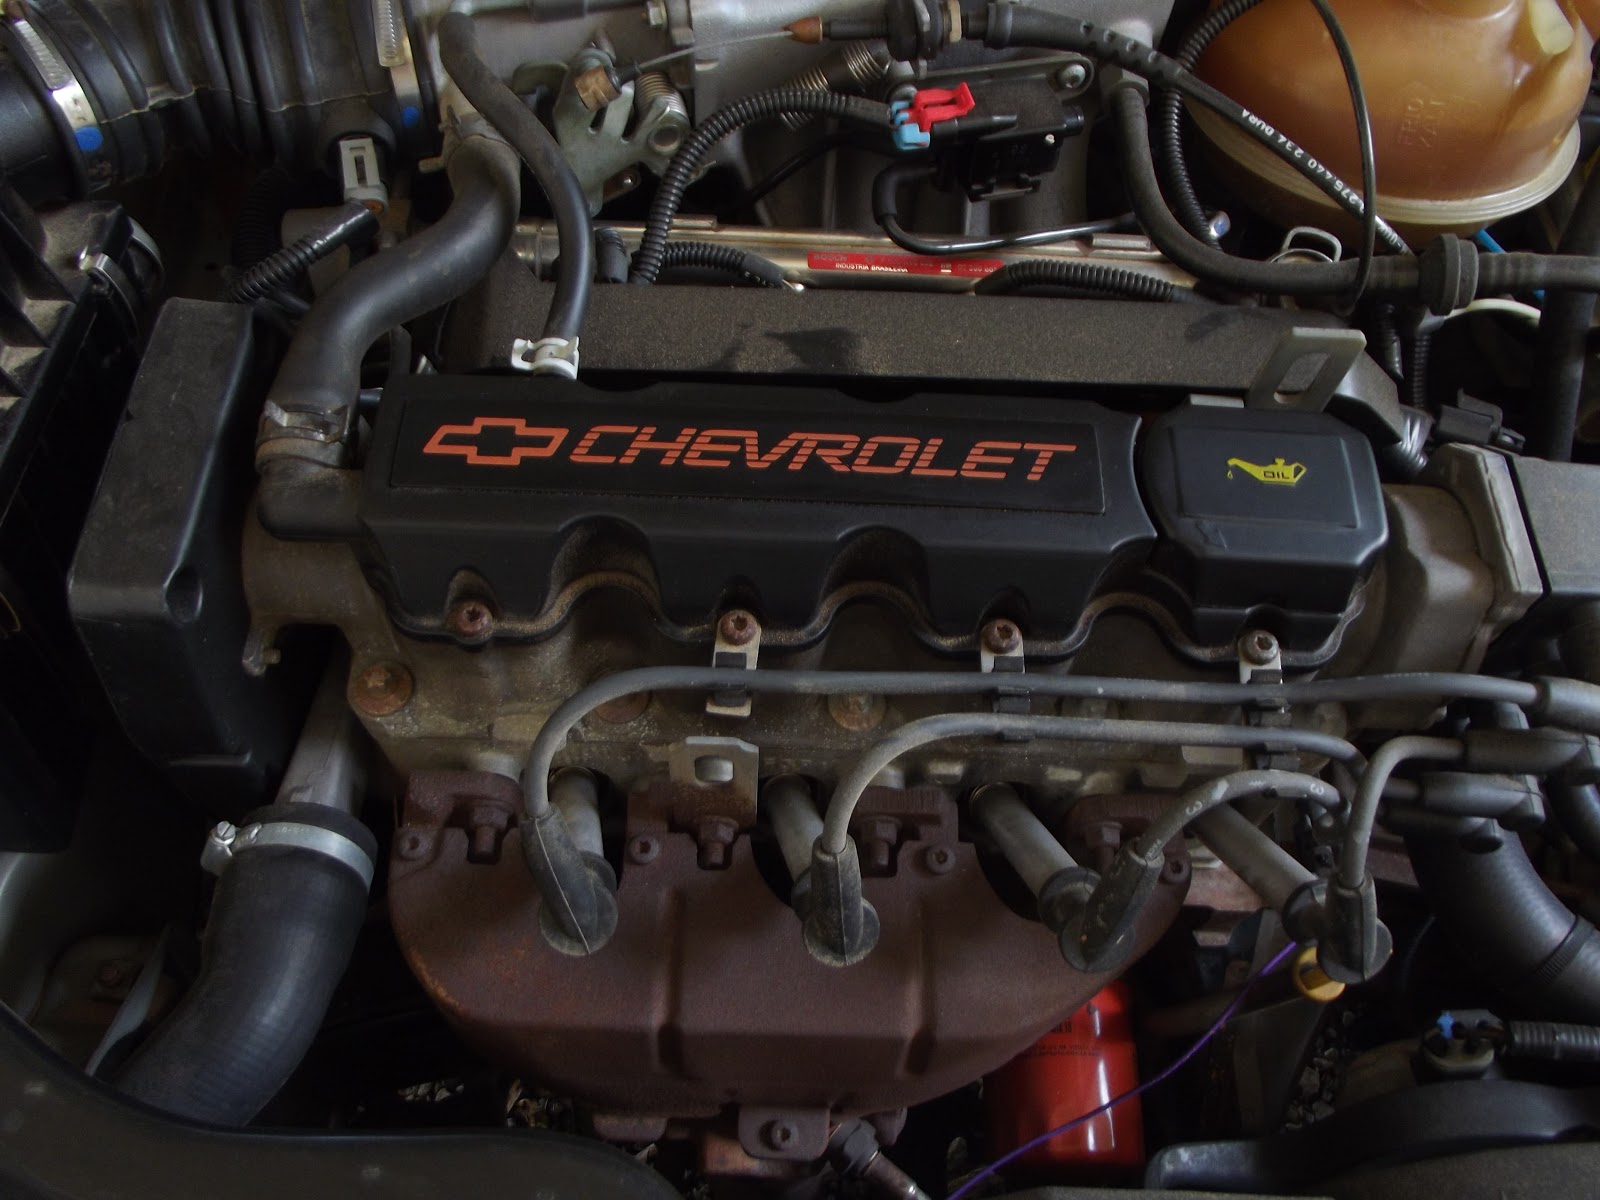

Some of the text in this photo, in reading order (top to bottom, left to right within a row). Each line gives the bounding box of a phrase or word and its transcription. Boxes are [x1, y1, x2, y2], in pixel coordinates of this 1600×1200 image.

[1242, 108, 1275, 136] DURA
[1277, 136, 1304, 157] 234
[813, 253, 847, 262] BOSCH
[569, 425, 1077, 482] CHEVROLET
[1263, 471, 1290, 479] OIL
